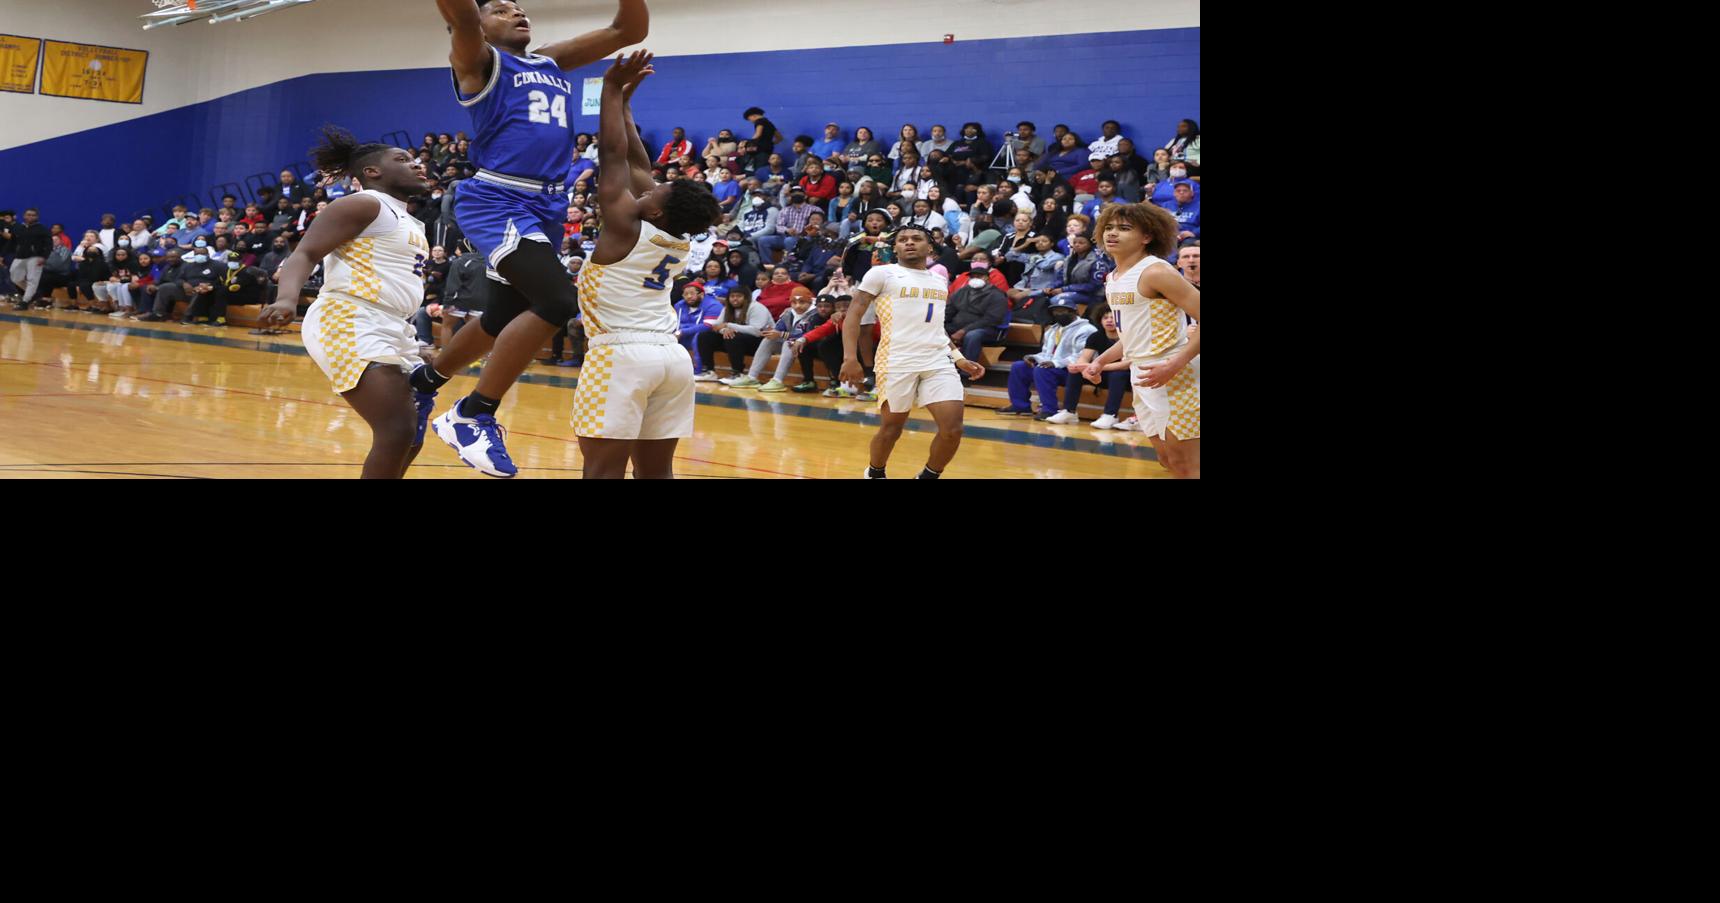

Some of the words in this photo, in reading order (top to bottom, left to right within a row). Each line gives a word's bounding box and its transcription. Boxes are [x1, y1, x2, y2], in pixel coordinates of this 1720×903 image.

[513, 71, 571, 94] CONNALLY
[528, 89, 568, 128] 24
[643, 254, 681, 290] 5
[900, 286, 920, 298] LA
[925, 303, 934, 323] 1
